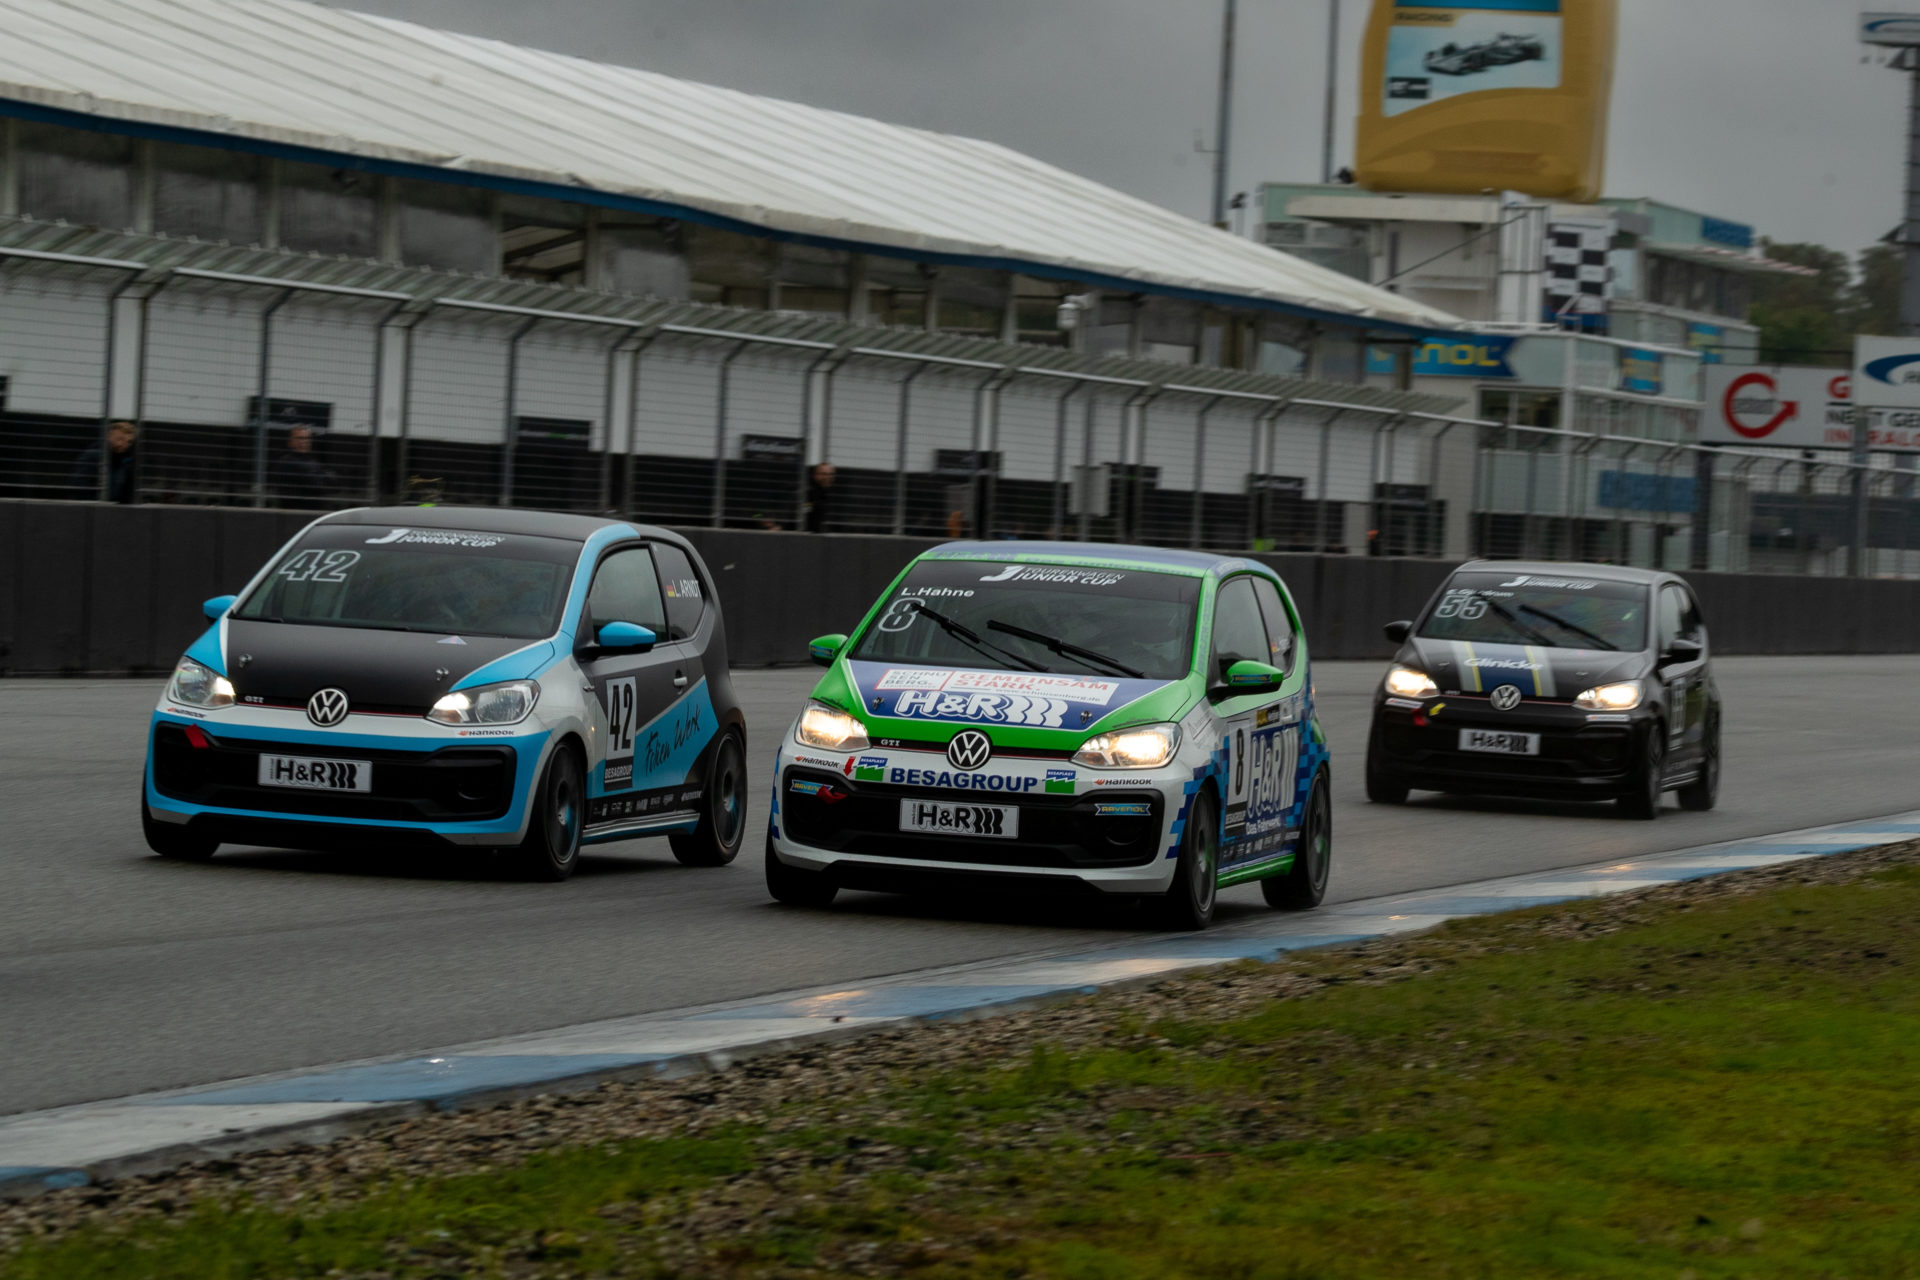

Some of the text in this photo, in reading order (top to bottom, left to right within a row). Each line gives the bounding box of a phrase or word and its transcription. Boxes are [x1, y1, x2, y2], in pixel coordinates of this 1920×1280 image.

[462, 539, 497, 548] CUP
[278, 549, 361, 582] 42
[1021, 567, 1125, 581] TOURENWAGEN
[1013, 572, 1119, 586] JUNIOR CUP
[878, 598, 925, 632] 8
[959, 673, 1110, 691] GEMEINSAM
[609, 683, 633, 751] 42
[896, 690, 1003, 721] H&R
[880, 739, 901, 747] GTI
[275, 759, 326, 785] H&R
[1235, 728, 1245, 796] 8
[890, 768, 1038, 792] BESAGROUP
[917, 804, 971, 830] H&R
